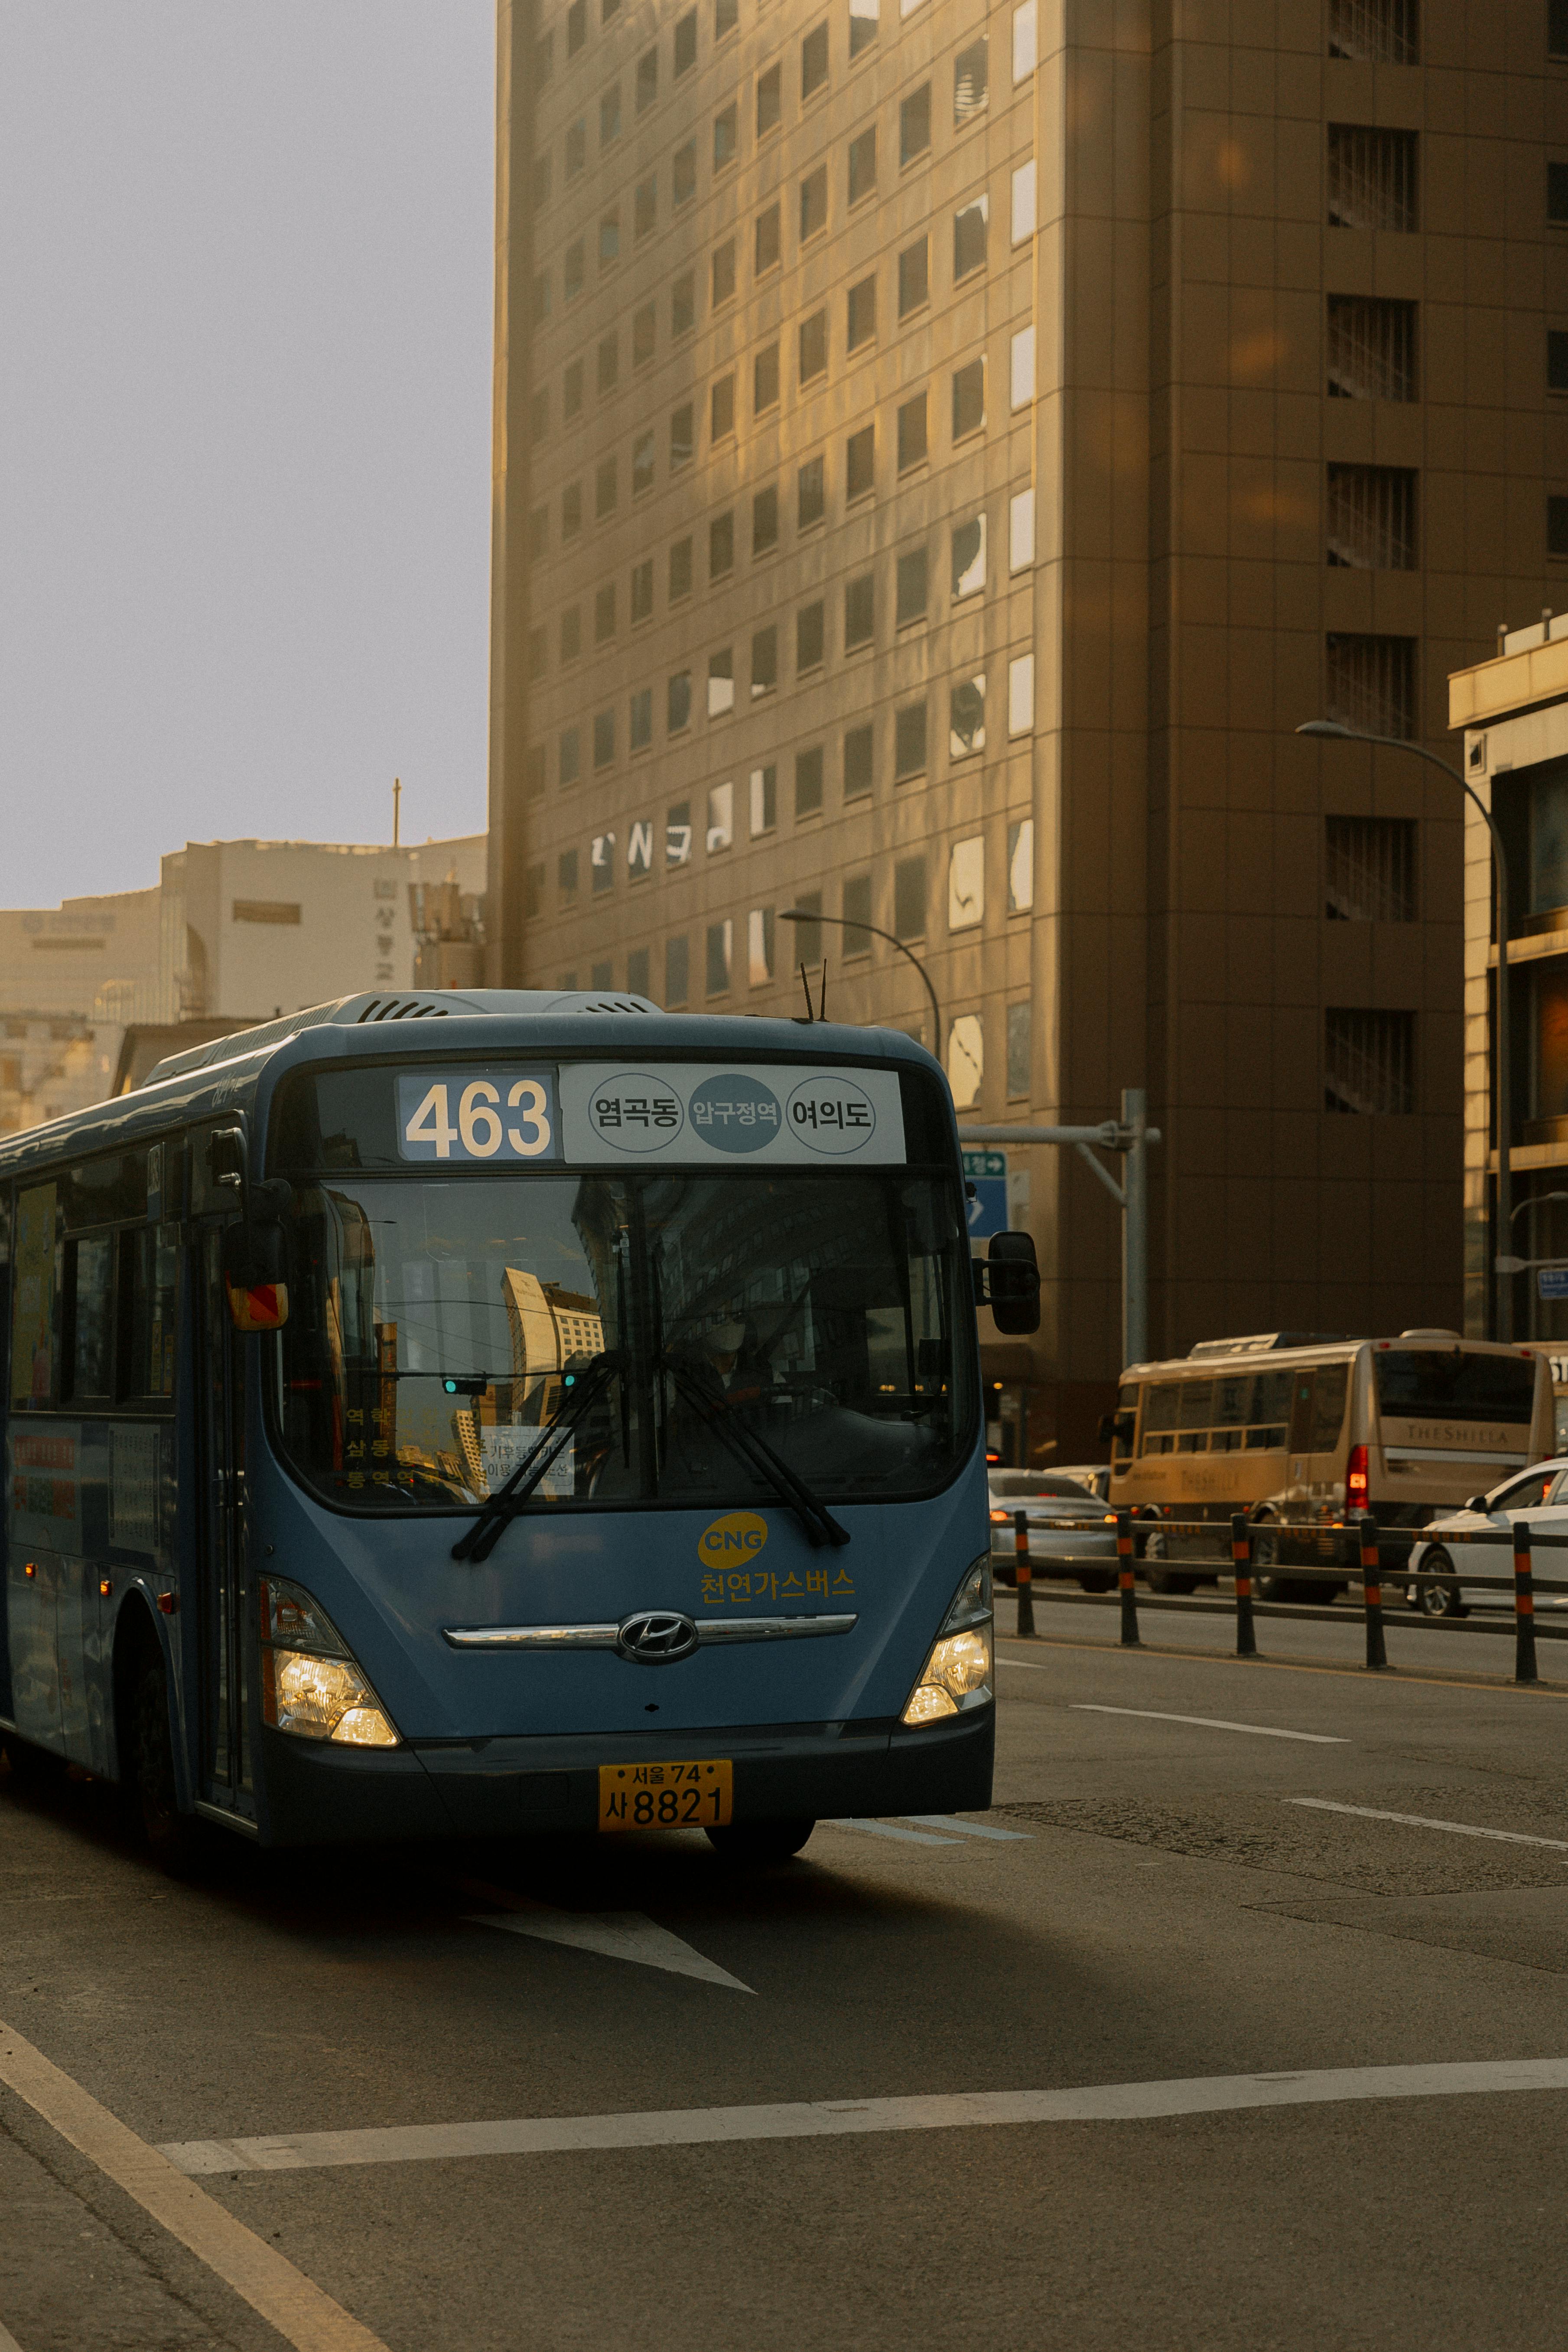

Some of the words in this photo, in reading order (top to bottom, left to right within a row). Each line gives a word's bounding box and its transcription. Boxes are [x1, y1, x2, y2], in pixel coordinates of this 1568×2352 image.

[406, 1080, 551, 1158] 463
[595, 1098, 679, 1128] 염곡동
[693, 1101, 778, 1126] 압구정역
[793, 1100, 872, 1130] 여의도
[487, 1463, 511, 1477] 이용
[704, 1530, 762, 1551] CNG
[701, 1569, 856, 1604] 천연가스버스
[632, 1766, 665, 1785] 서울
[671, 1765, 701, 1783] 74
